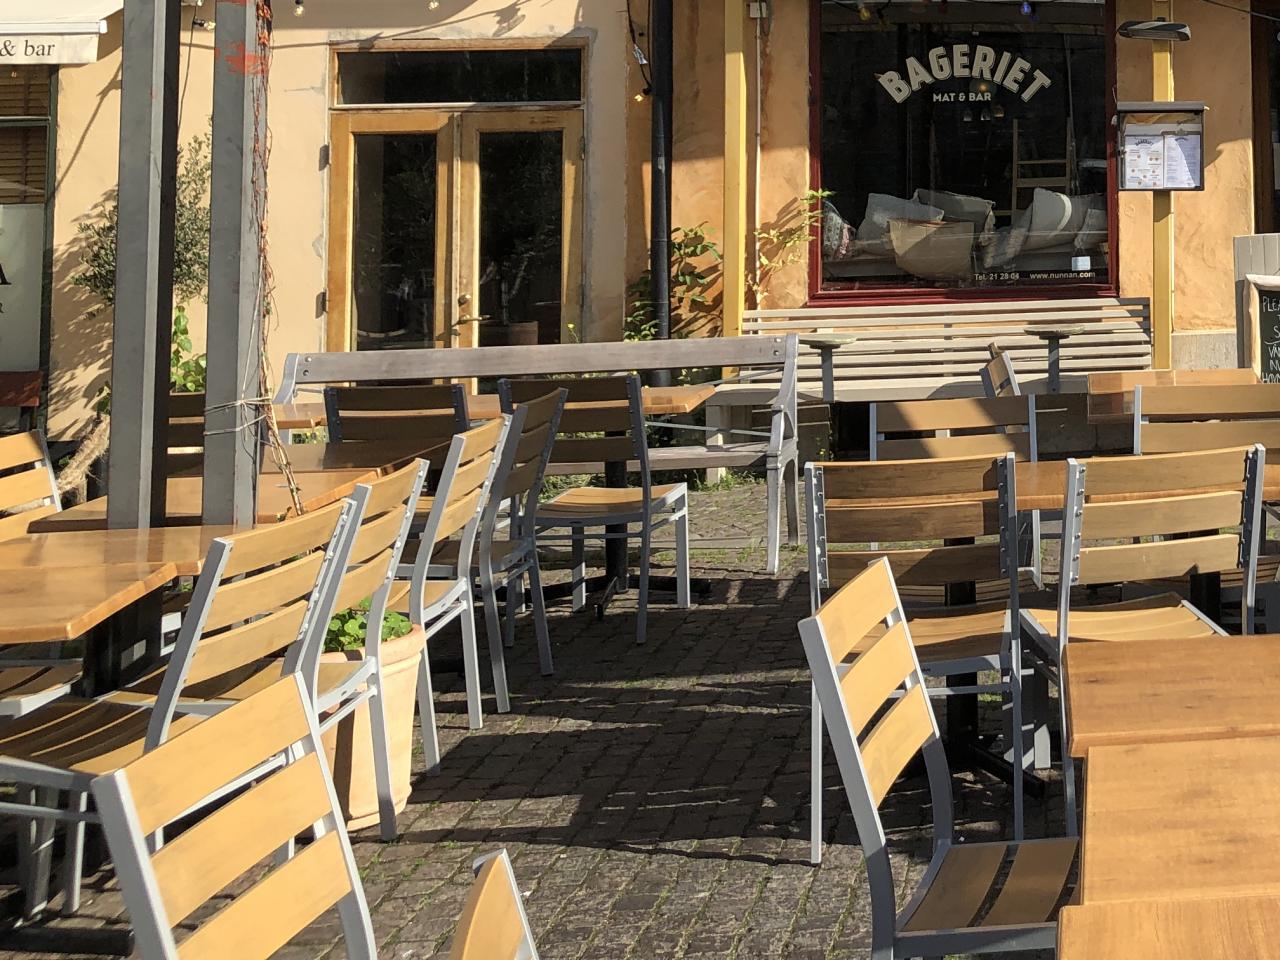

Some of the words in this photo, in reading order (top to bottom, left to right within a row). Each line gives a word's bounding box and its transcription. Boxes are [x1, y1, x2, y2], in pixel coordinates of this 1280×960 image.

[0, 40, 16, 57] &
[24, 40, 55, 56] bar
[878, 44, 1052, 104] BAGERIET
[932, 92, 956, 102] MAT
[959, 92, 966, 102] &
[969, 92, 992, 102] BAR
[1000, 272, 1009, 280] 28
